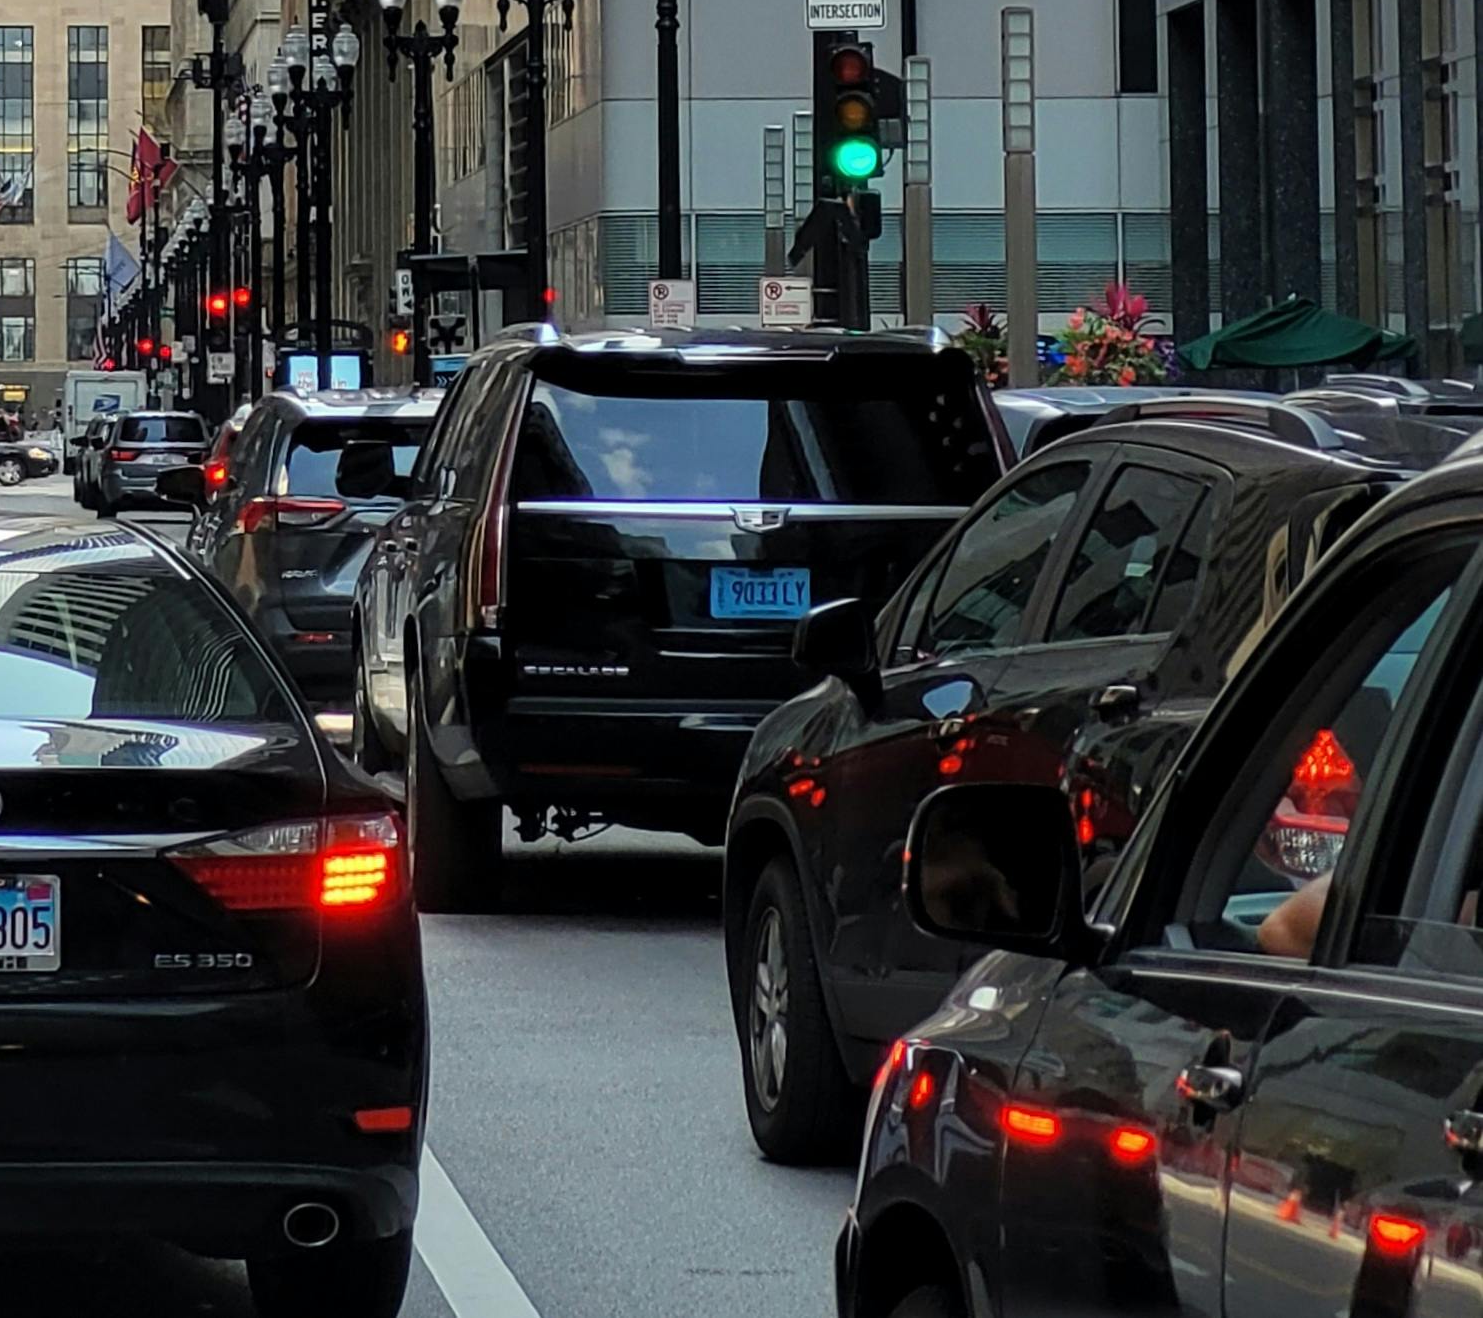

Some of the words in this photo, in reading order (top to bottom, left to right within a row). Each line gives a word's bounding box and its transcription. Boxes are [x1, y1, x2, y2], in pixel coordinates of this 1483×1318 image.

[810, 4, 881, 19] INTERSECTION
[782, 581, 806, 606] LY
[524, 666, 629, 676] ESCALADE
[155, 954, 192, 968] ES
[198, 953, 252, 968] 350
